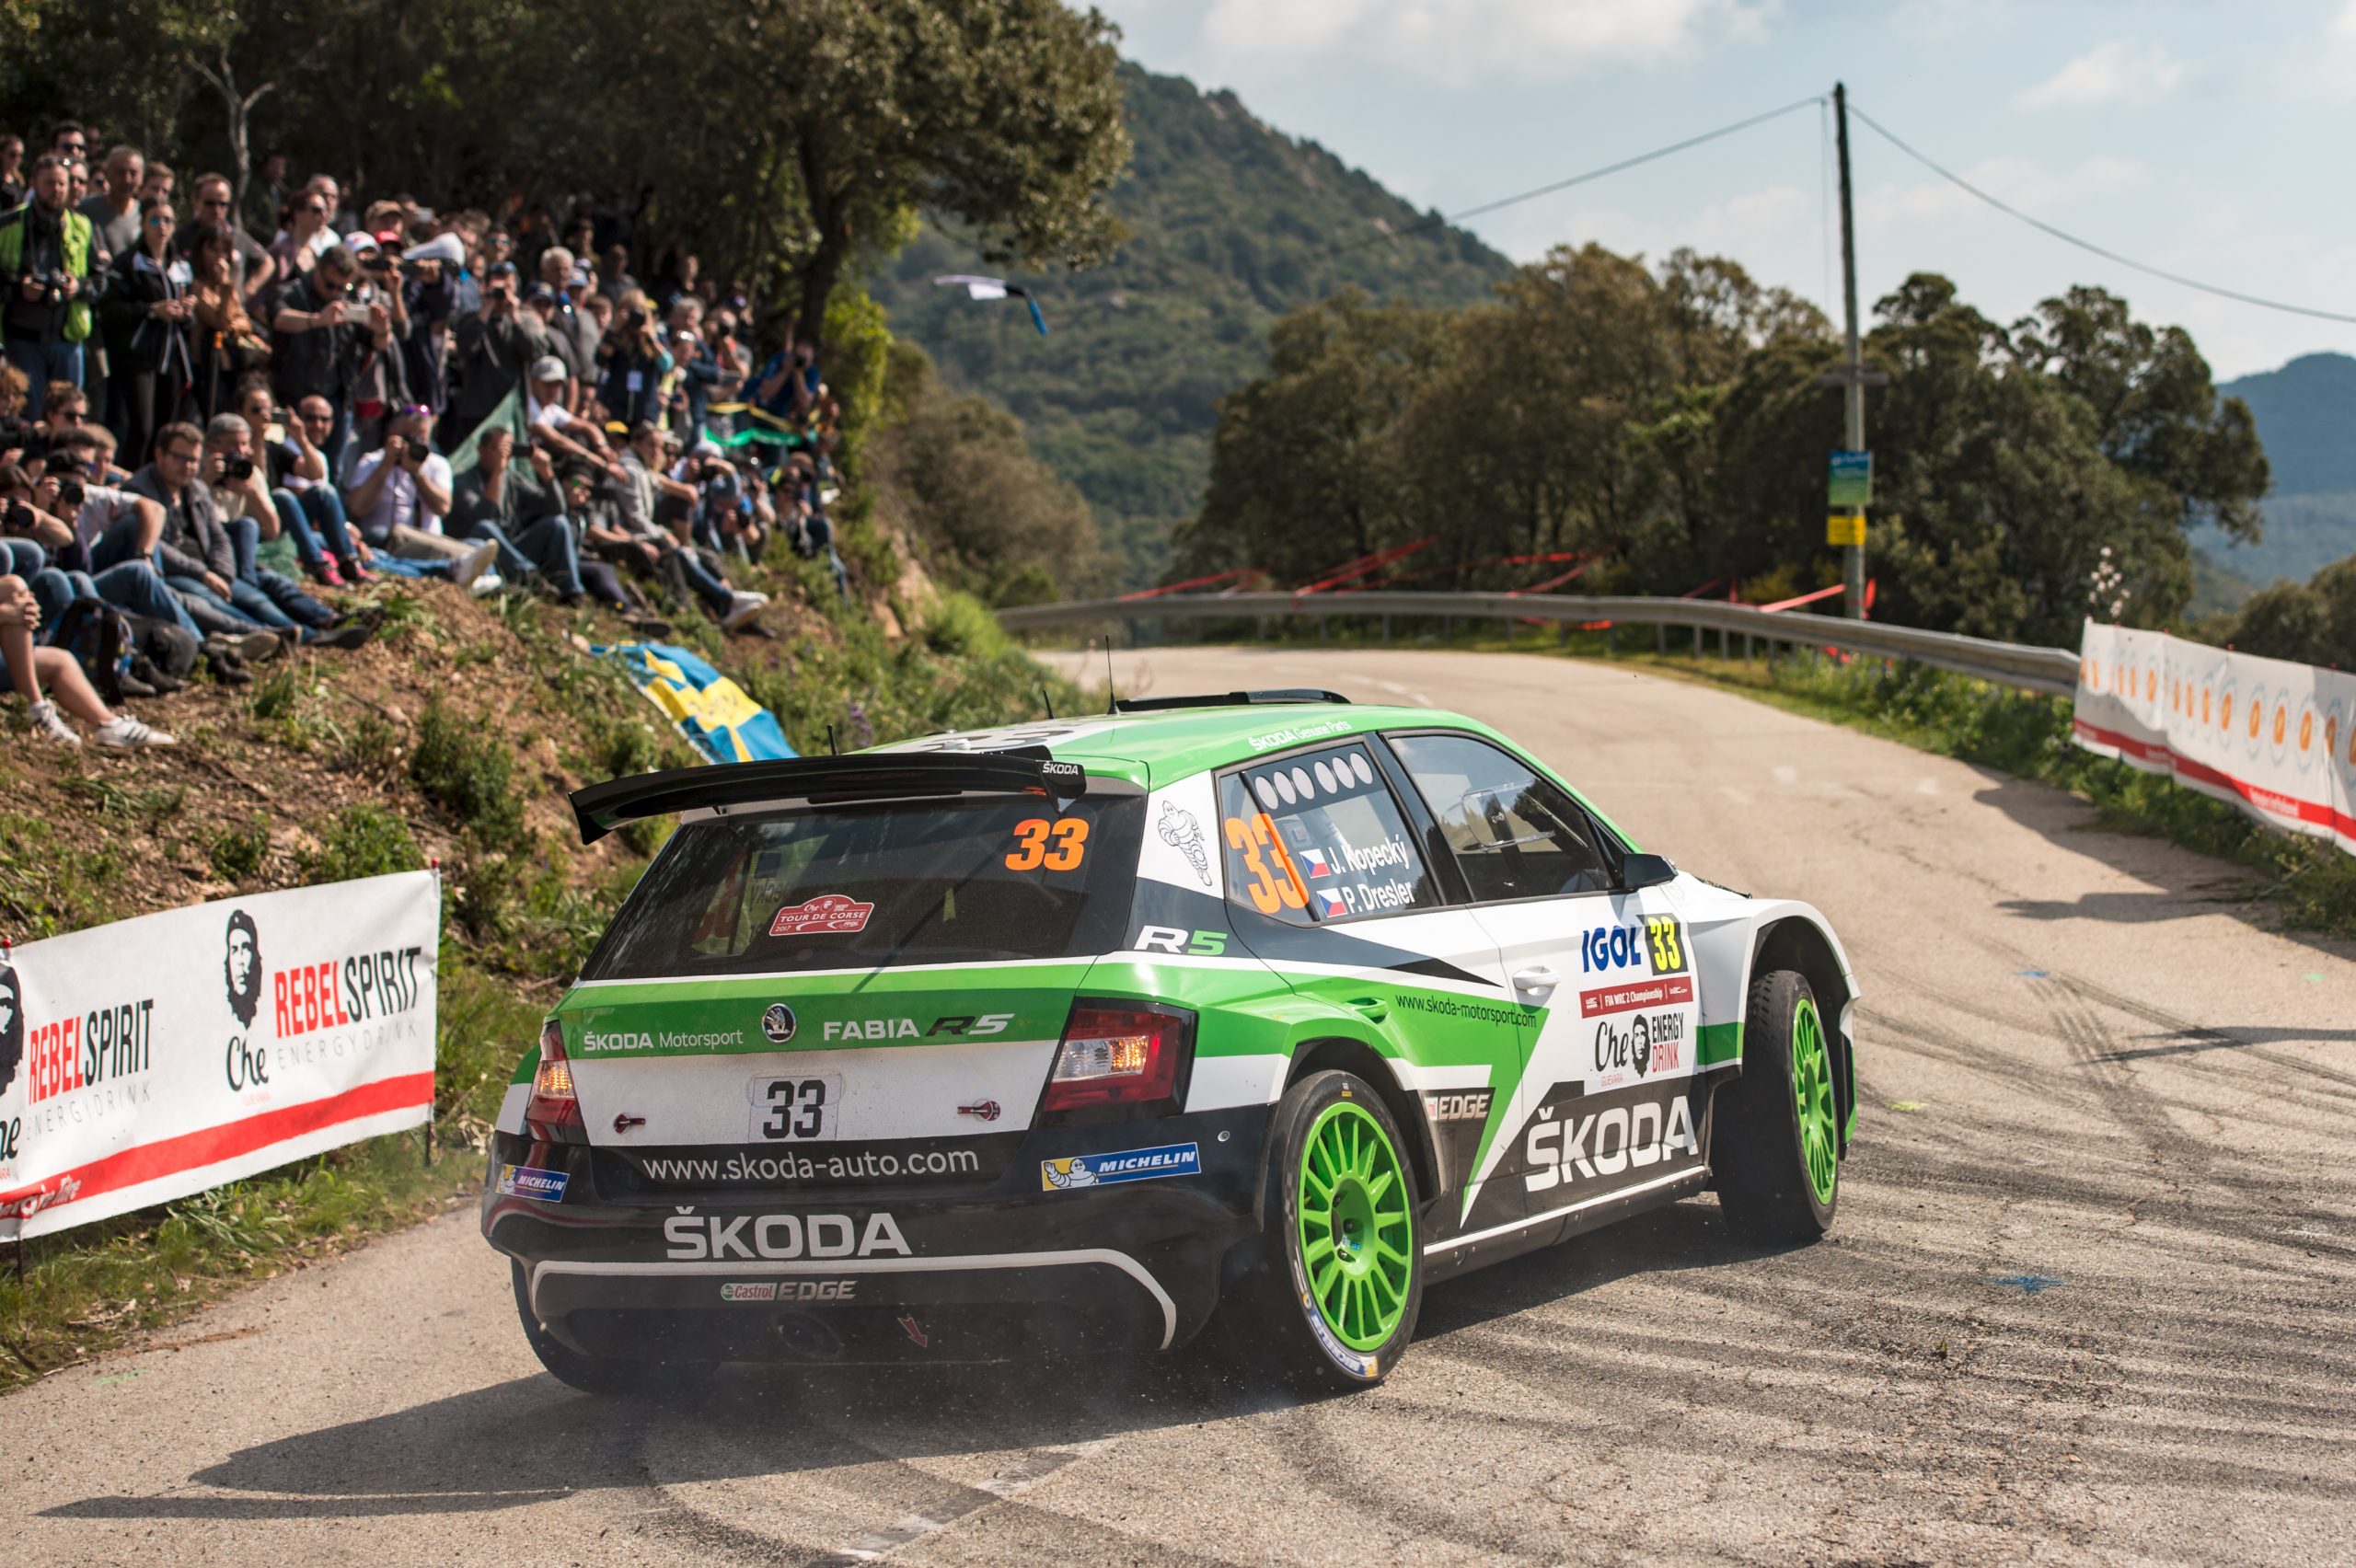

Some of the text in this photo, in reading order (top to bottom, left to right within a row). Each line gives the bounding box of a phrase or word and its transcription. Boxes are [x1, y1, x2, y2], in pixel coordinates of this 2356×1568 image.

[1248, 729, 1299, 752] ŠKODA
[1042, 760, 1080, 776] ŠKODA
[1005, 818, 1091, 871] 33
[1328, 834, 1410, 876] J. Kopecký
[1223, 812, 1310, 915] 33
[1341, 878, 1415, 914] P. Dresler
[780, 914, 810, 923] TOUR
[829, 911, 866, 920] CORSE
[1133, 925, 1229, 957] R5
[1581, 924, 1642, 974] IGOL
[1647, 916, 1681, 972] 33
[824, 1013, 1016, 1041] FABIA R5
[1395, 995, 1537, 1028] www.skoda-motorsport.com
[583, 1029, 745, 1052] ŠKODA Motorsport
[1651, 1012, 1684, 1044] ENERGY
[1595, 1020, 1629, 1073] Che
[1651, 1041, 1680, 1073] DRINK
[225, 1035, 269, 1092] Che
[763, 1079, 826, 1139] 33
[1438, 1093, 1491, 1120] EDGE
[1525, 1095, 1699, 1193] ŠKODA
[642, 1149, 980, 1181] www.skoda-auto.com
[1098, 1151, 1196, 1173] MICHELIN
[516, 1174, 566, 1192] MICHELIN
[664, 1205, 914, 1260] ŠKODA
[734, 1280, 859, 1300] Castrol EDGE
